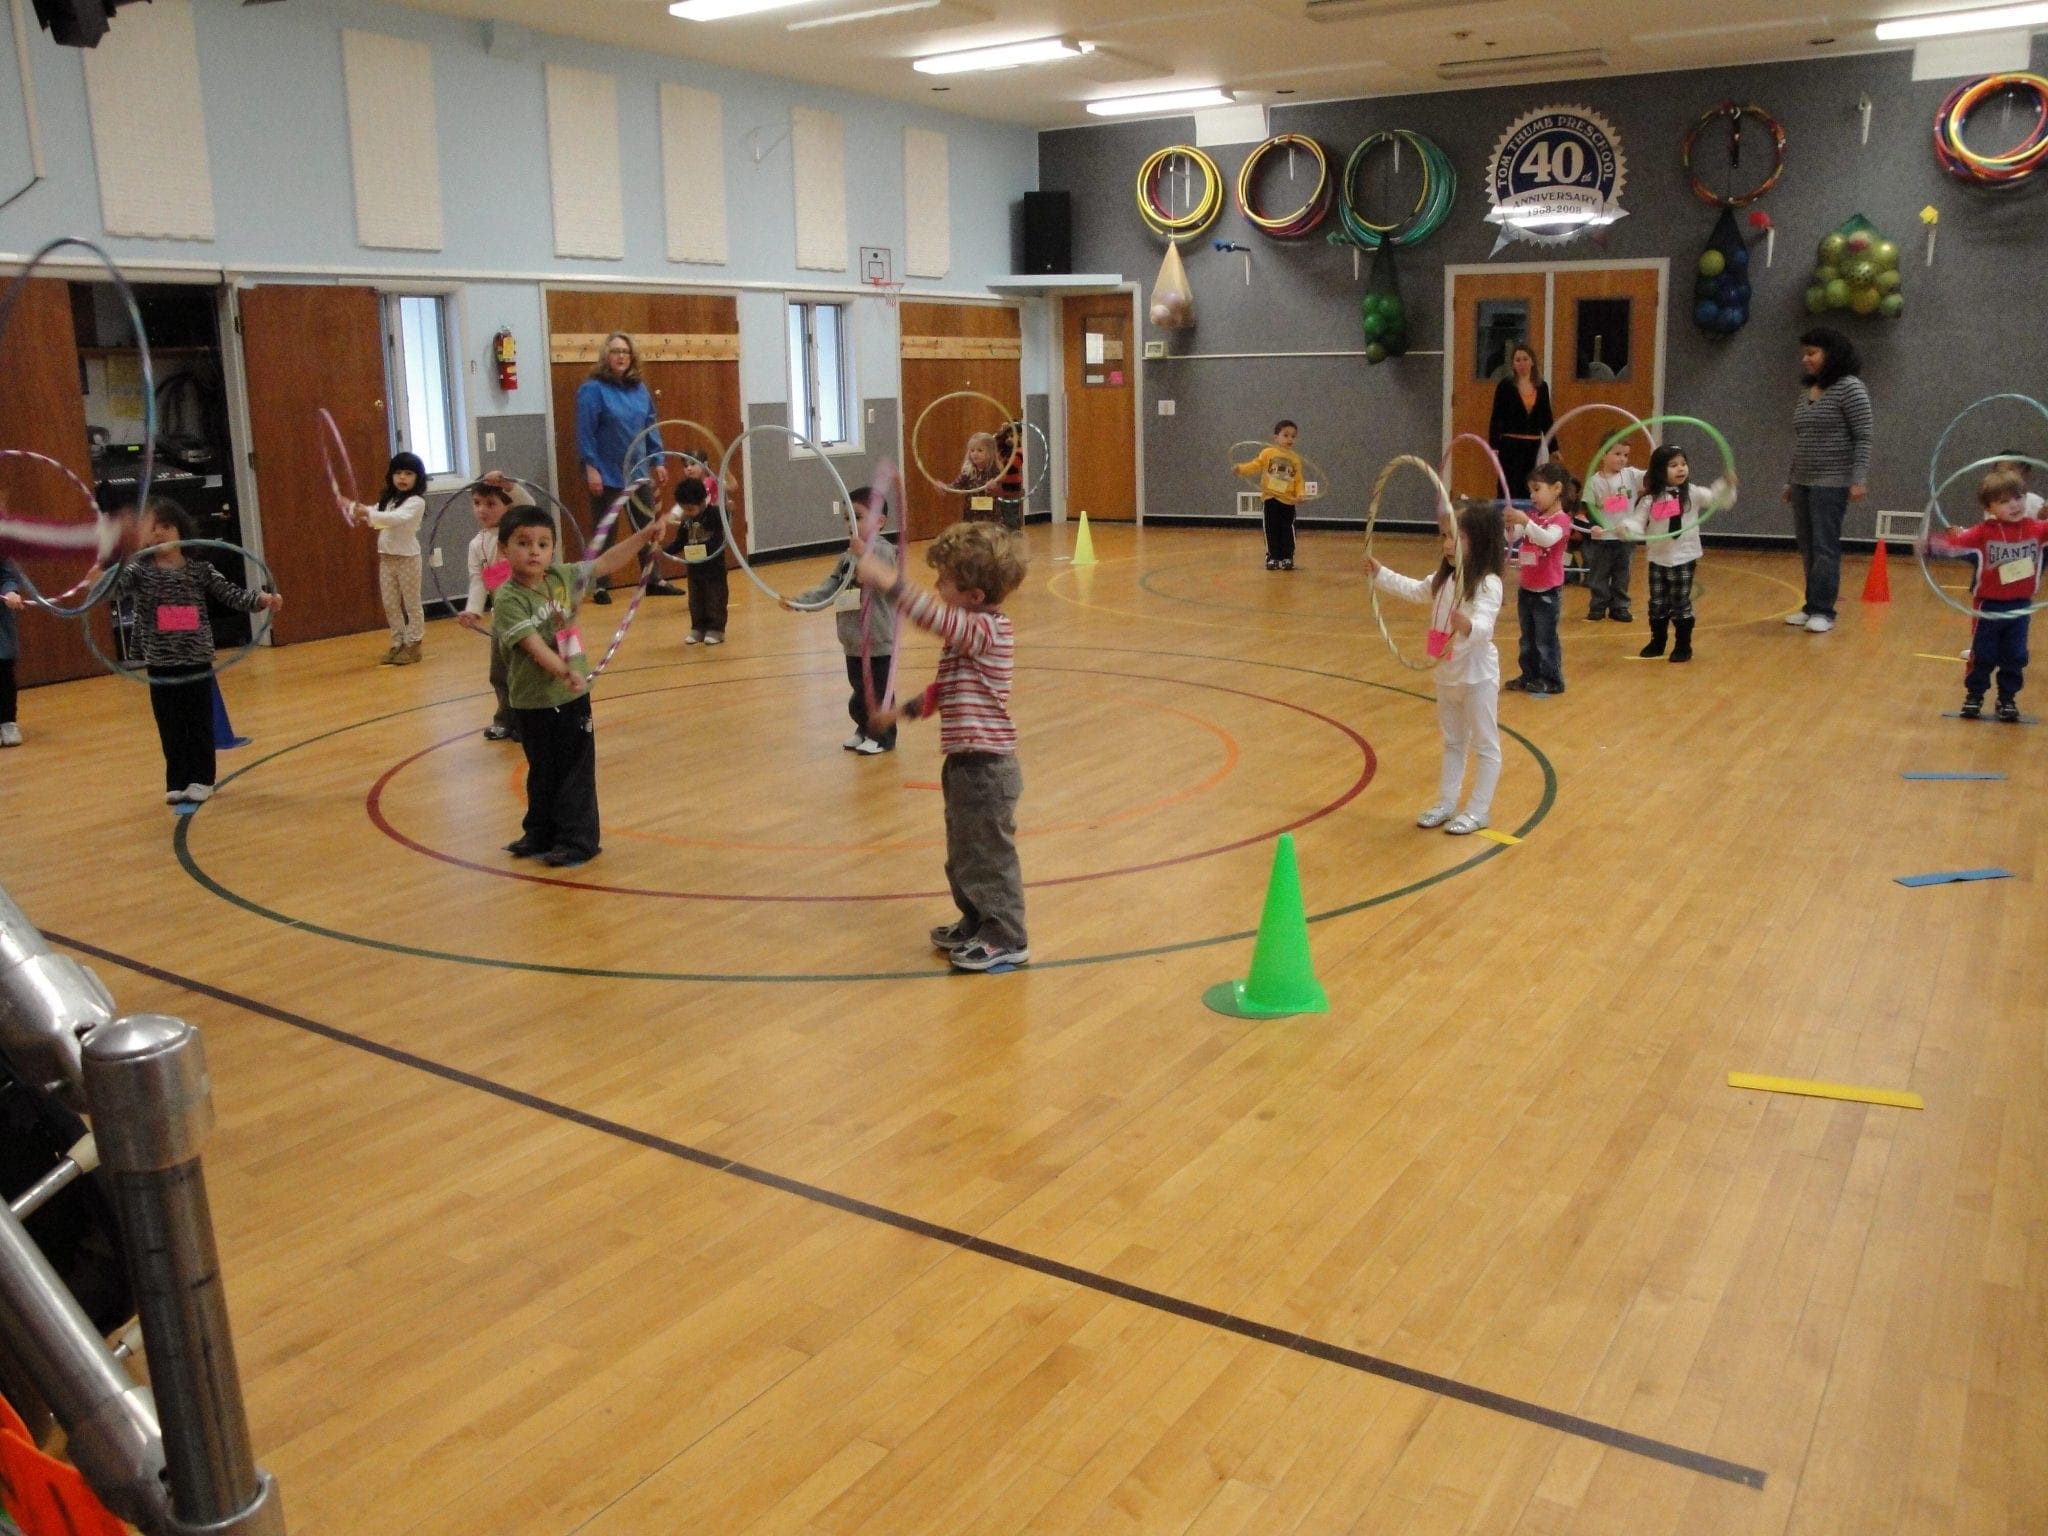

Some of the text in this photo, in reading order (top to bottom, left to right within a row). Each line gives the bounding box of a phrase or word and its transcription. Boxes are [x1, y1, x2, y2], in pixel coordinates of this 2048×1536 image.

[1498, 116, 1614, 188] TOM THUMB PRESCHOOL
[1513, 191, 1598, 209] ANNIVERSARY
[1989, 543, 2037, 565] GIANTS
